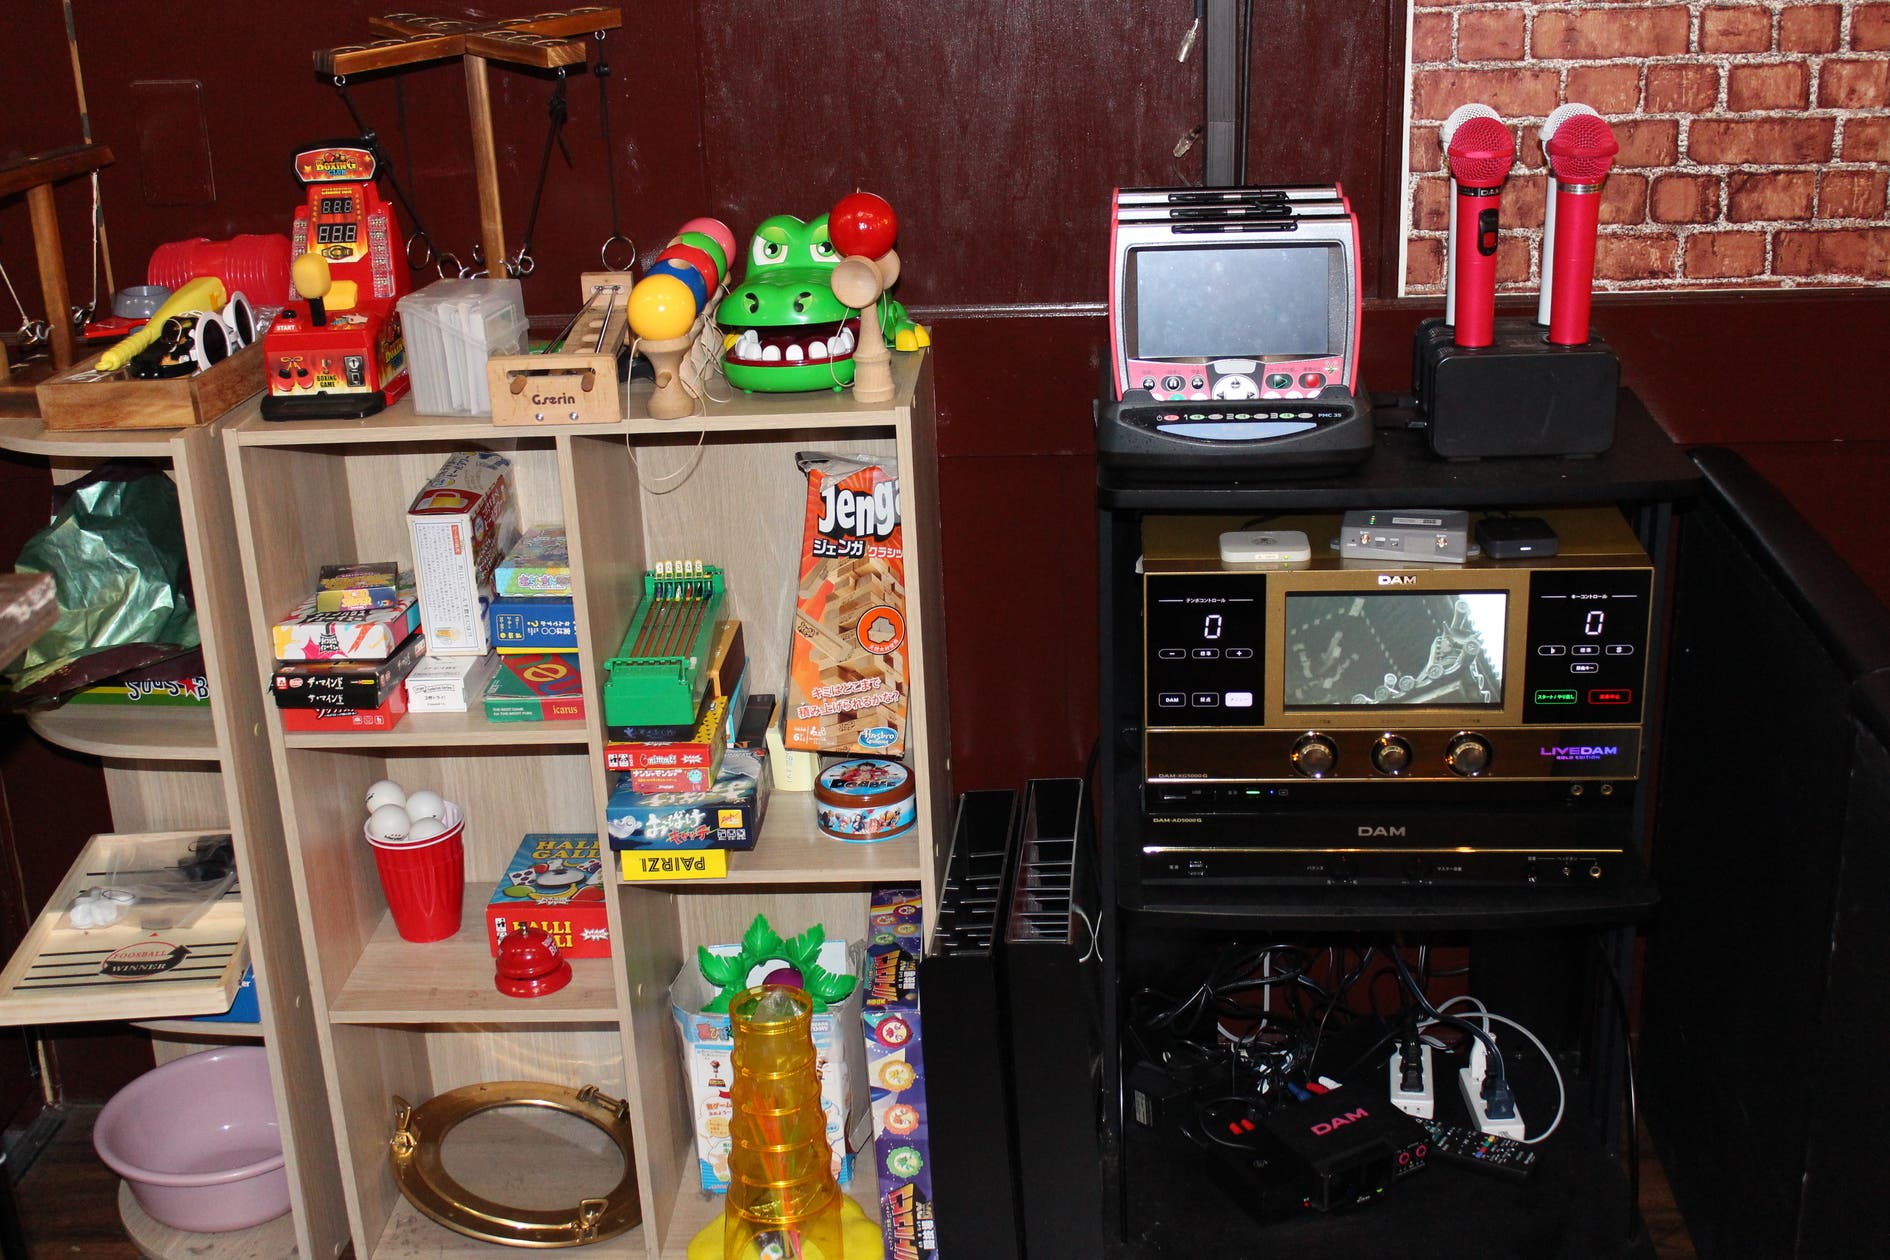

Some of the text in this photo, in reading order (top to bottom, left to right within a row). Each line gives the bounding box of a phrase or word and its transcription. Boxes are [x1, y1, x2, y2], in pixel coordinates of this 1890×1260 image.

[315, 159, 356, 171] BOXING
[531, 392, 576, 405] Gserin
[813, 539, 864, 556] ジェンガ
[1377, 575, 1417, 585] DAM
[1203, 614, 1223, 640] 0
[1585, 610, 1605, 636] 0
[811, 677, 881, 699] キミはどこまで
[551, 701, 579, 714] icarus
[643, 809, 707, 840] おばけ
[1357, 826, 1407, 837] DAM
[667, 824, 712, 844] キャッチ
[640, 855, 706, 873] PAIRZI
[113, 950, 168, 960] FOOSBALL
[111, 962, 167, 972] WINNER
[1310, 1107, 1370, 1136] DAM
